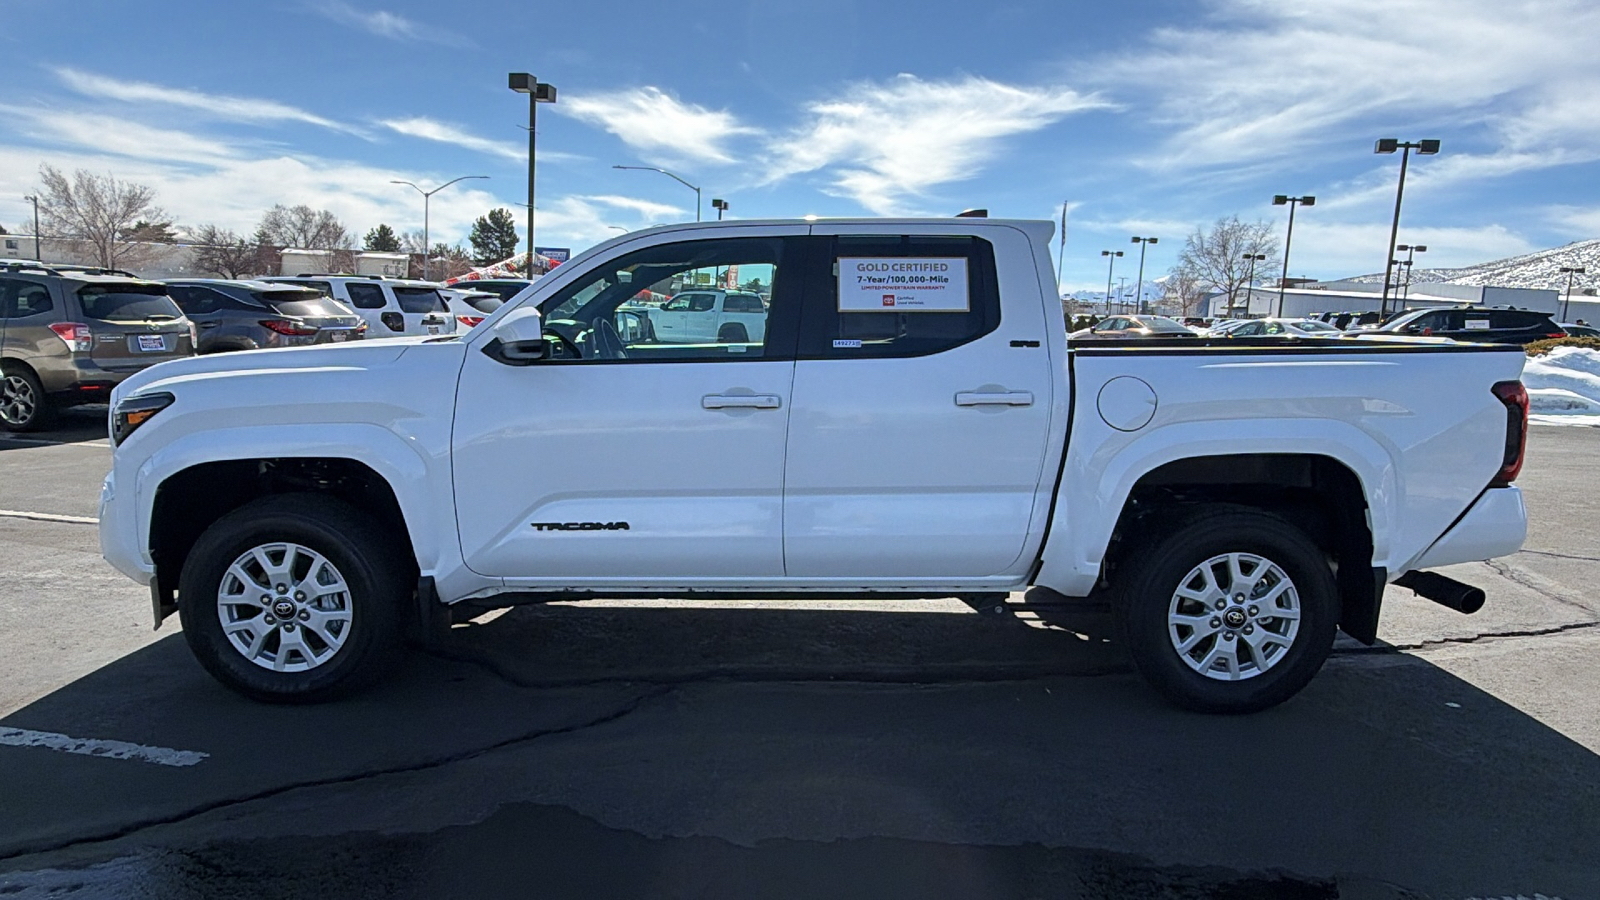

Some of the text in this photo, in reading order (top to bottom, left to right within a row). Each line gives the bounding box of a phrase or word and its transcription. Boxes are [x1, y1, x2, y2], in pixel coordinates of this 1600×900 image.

[856, 263, 949, 272] GOLD CERTIFIED
[856, 275, 950, 284] 7-Year/100,000-Mile
[530, 522, 630, 531] TACOMA
